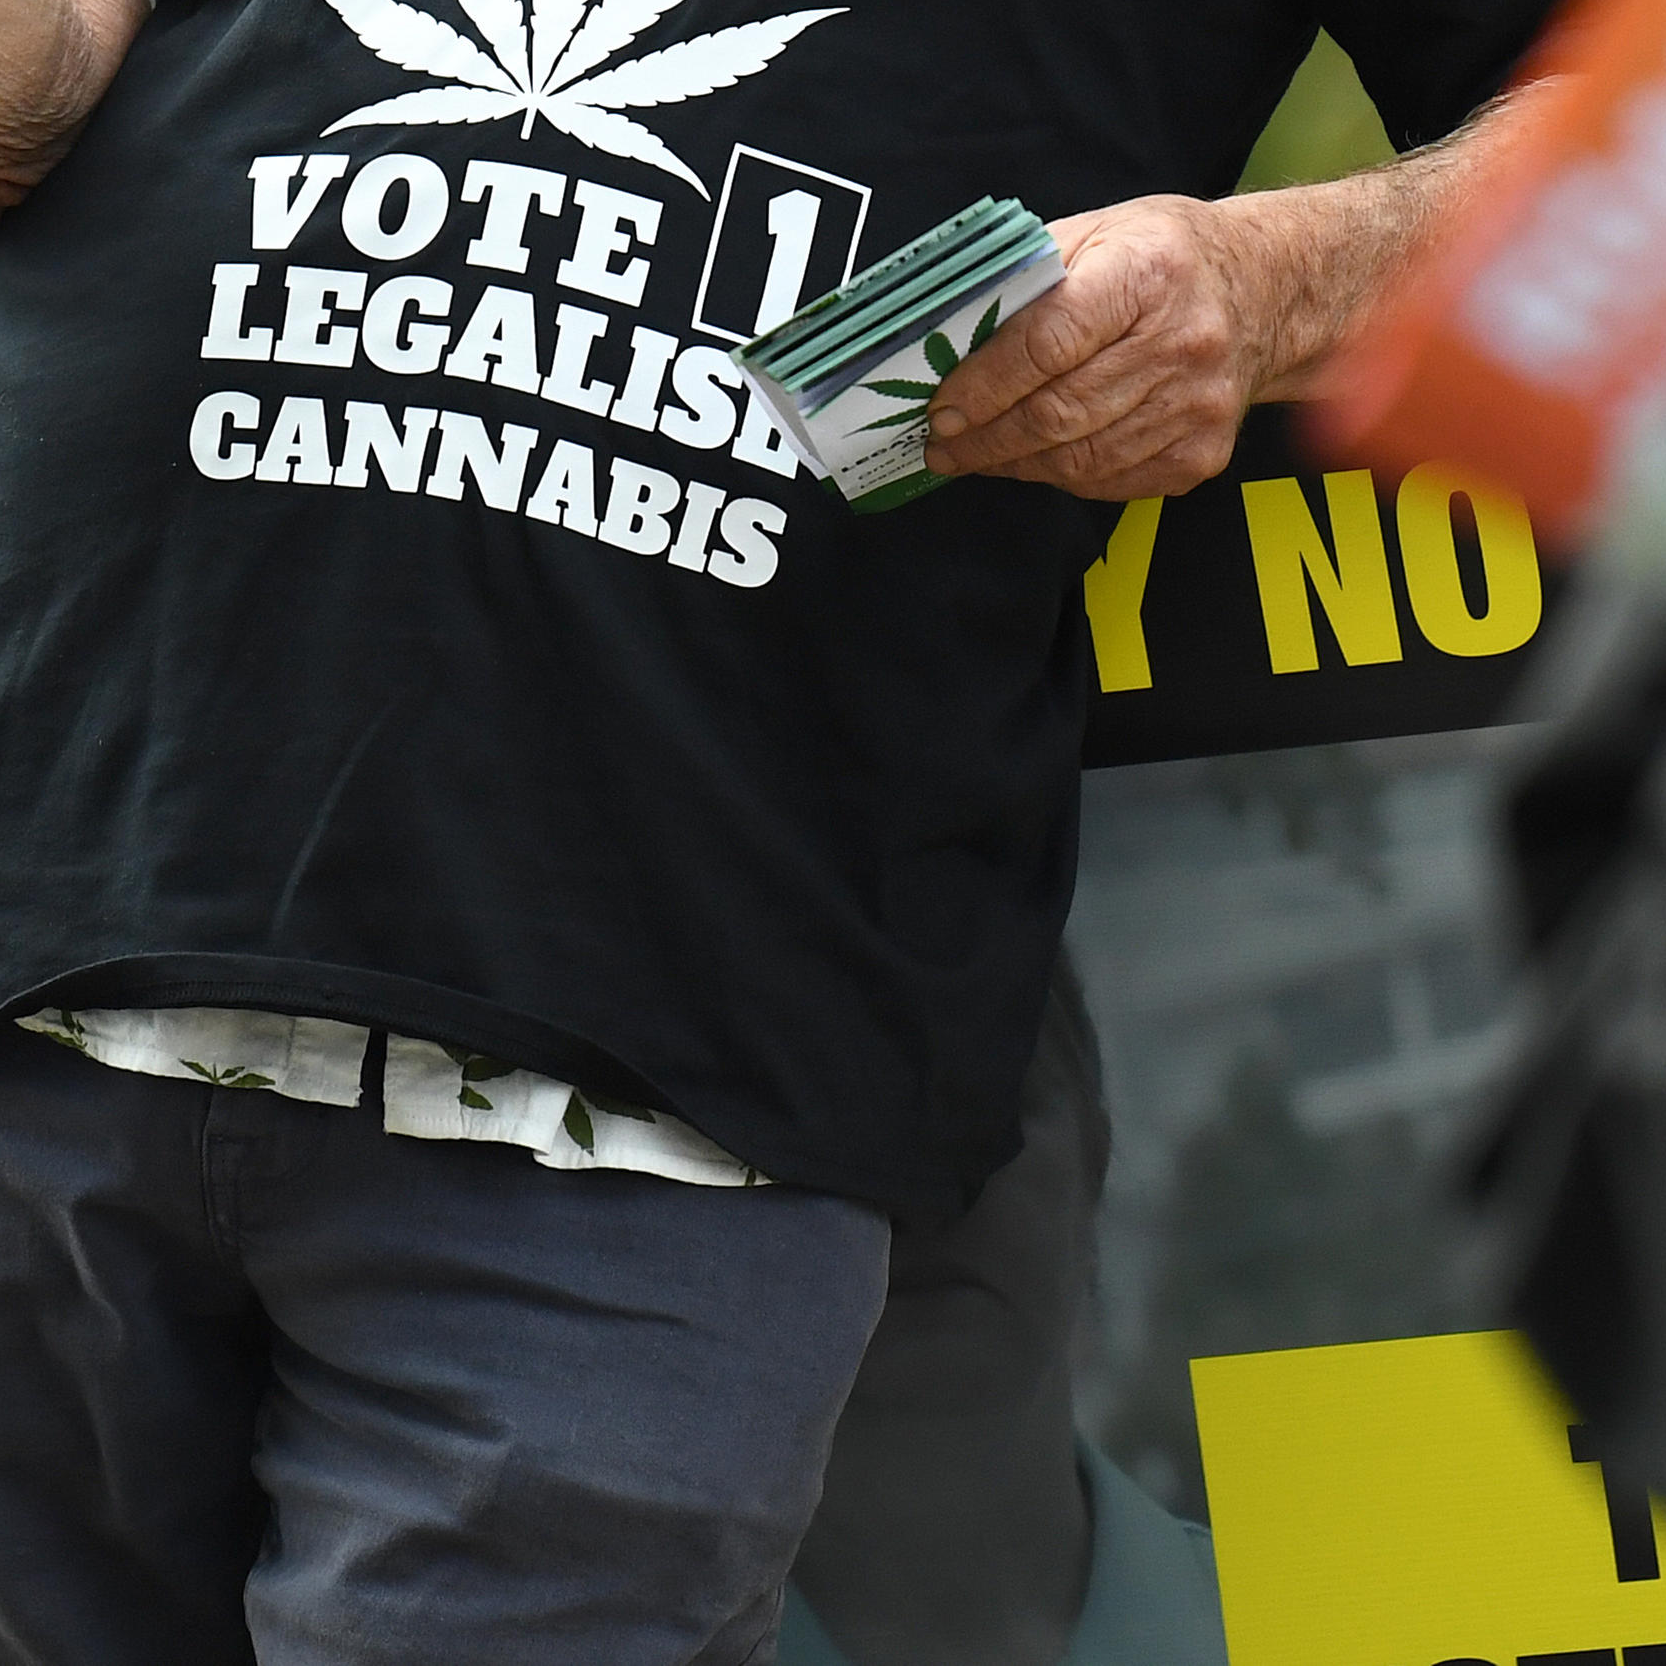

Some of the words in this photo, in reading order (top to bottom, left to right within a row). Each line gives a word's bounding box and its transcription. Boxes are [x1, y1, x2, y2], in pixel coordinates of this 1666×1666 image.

[248, 153, 663, 307] VOTE
[754, 189, 823, 336] 1
[188, 391, 788, 588] CANNABIS
[1240, 459, 1543, 675] NO
